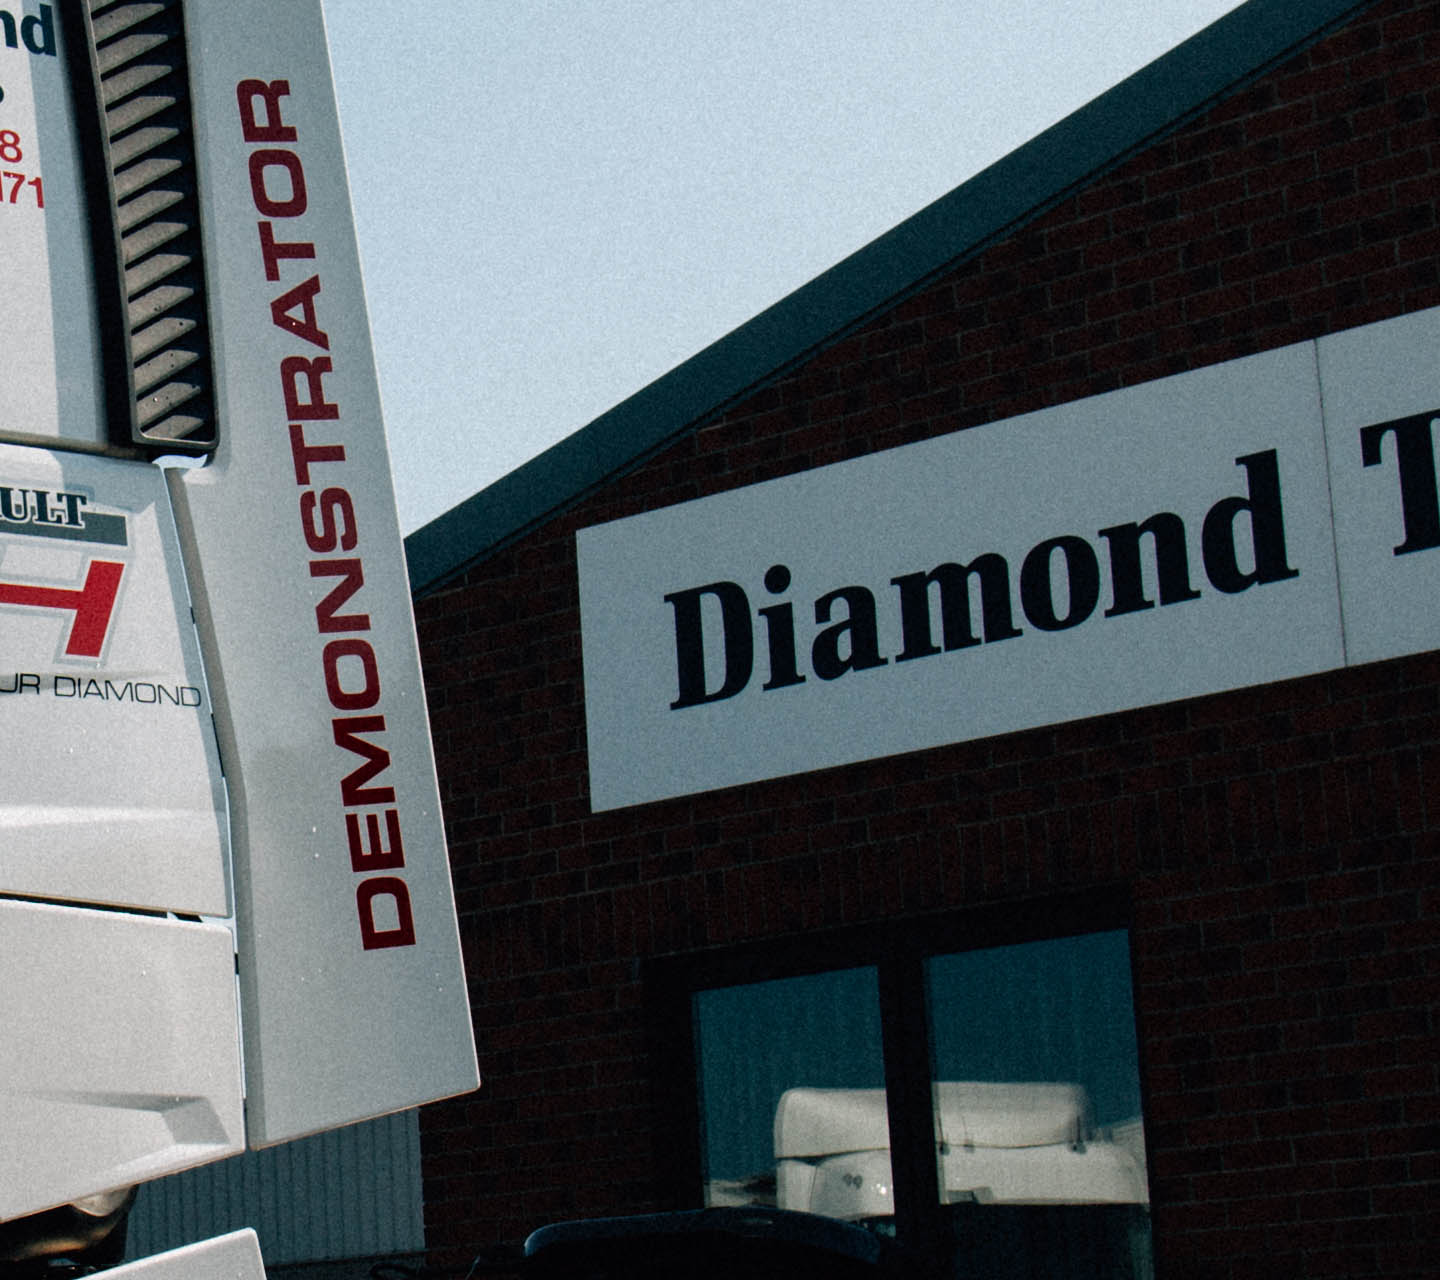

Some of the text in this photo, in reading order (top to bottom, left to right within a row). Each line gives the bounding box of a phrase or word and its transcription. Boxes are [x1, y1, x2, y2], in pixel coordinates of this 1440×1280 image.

[237, 77, 416, 952] DEMONSTRATOR
[663, 449, 1299, 710] Diamond
[54, 675, 202, 709] DIAMOND
